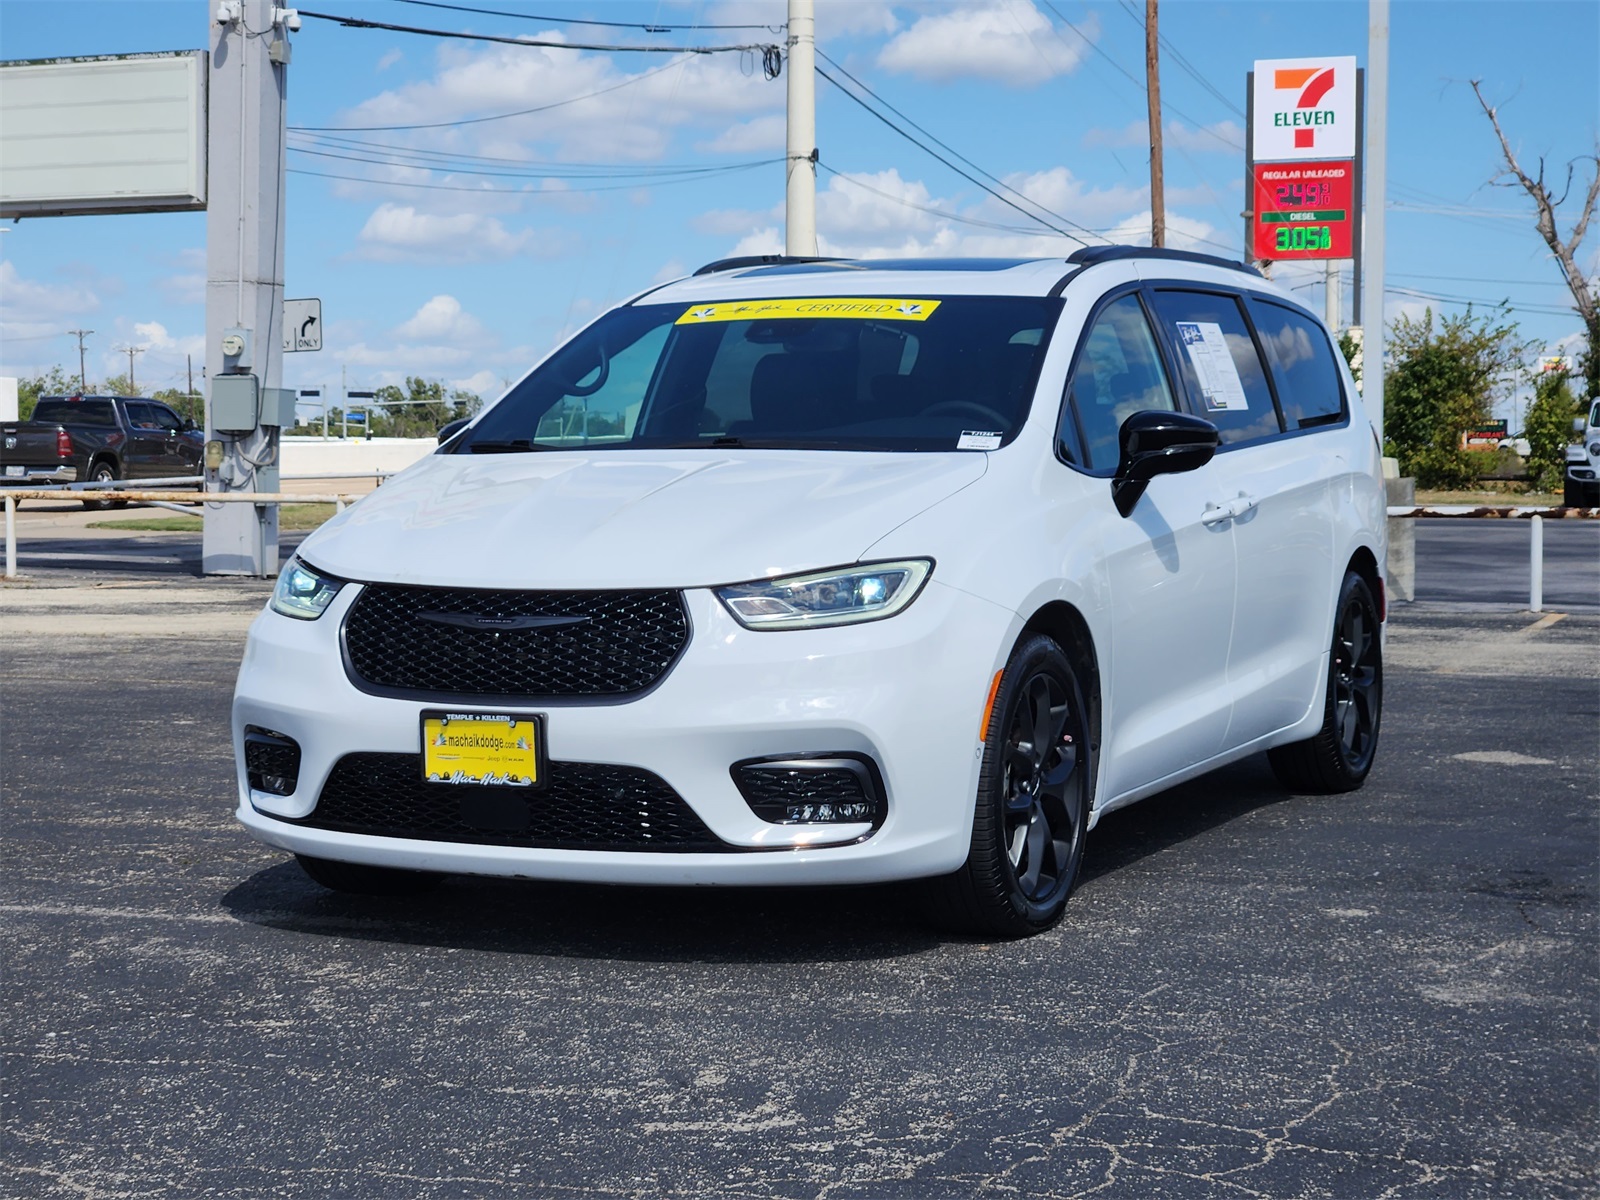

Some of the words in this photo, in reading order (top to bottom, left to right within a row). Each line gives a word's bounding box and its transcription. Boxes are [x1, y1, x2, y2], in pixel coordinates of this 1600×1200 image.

[1274, 67, 1335, 148] 7
[1262, 170, 1301, 180] REGULAR
[1302, 169, 1345, 179] UNLEADED
[1275, 183, 1320, 207] 2.49
[1290, 212, 1317, 221] DIESEL
[796, 303, 893, 314] CERTIFIED
[298, 338, 318, 348] ONLY
[448, 734, 515, 751] machaikdodge.com
[450, 770, 476, 785] Mac
